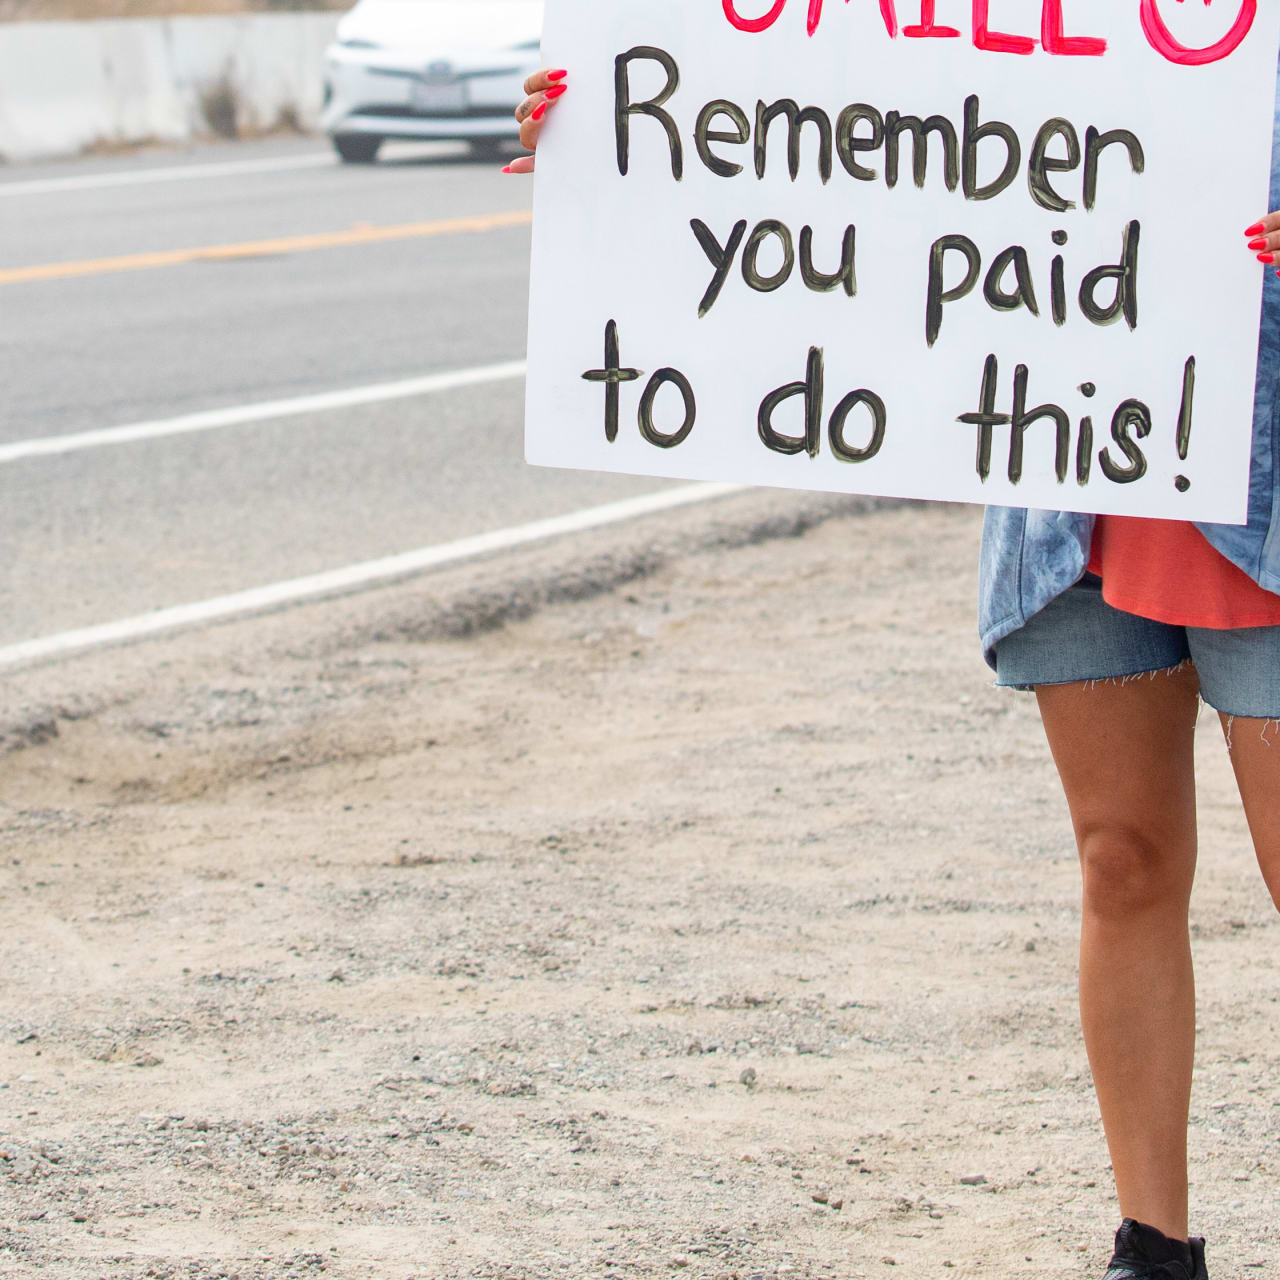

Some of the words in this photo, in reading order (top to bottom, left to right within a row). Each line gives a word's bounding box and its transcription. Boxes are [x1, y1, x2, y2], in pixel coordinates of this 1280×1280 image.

[614, 45, 1145, 213] Remember
[689, 218, 857, 319] you
[925, 219, 1141, 348] paid
[580, 318, 697, 449] to
[757, 345, 888, 463] do
[956, 353, 1196, 493] this!
